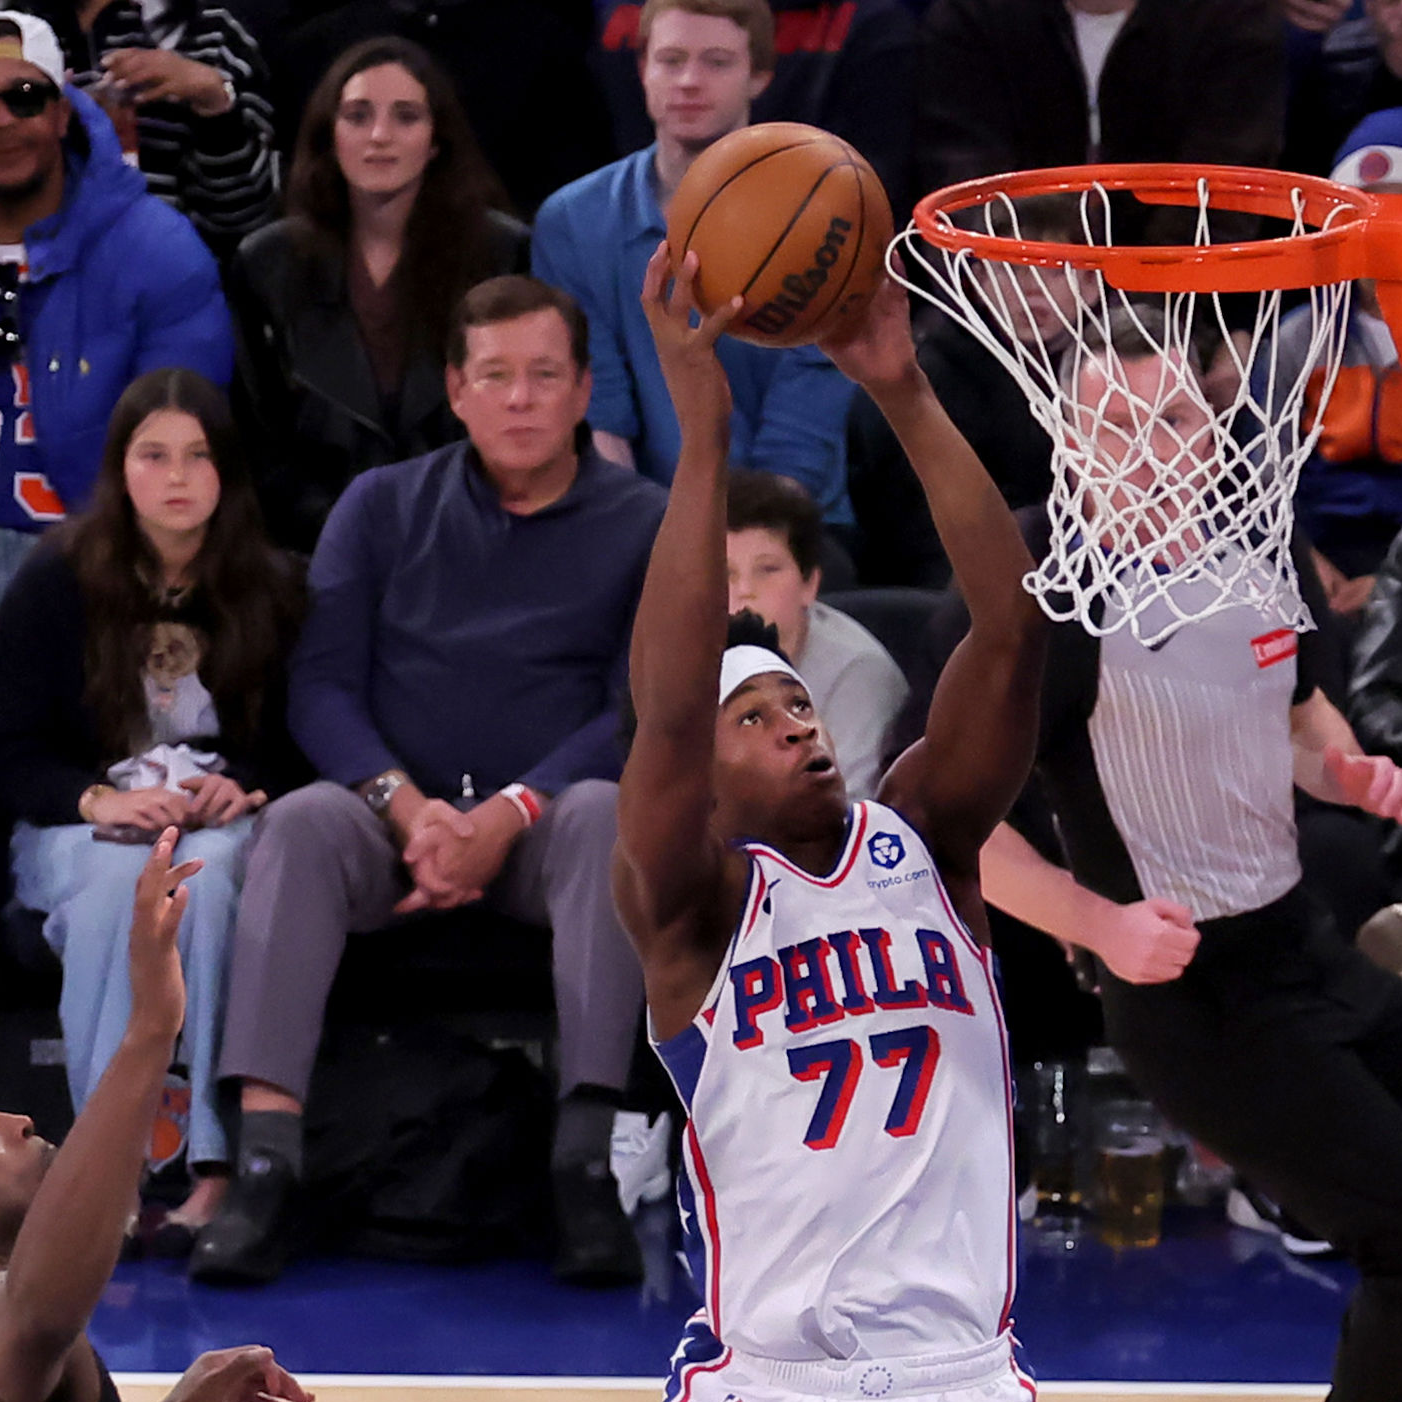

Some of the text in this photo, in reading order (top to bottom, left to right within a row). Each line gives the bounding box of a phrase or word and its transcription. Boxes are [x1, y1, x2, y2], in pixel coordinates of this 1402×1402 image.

[745, 217, 852, 334] Wilson
[730, 927, 976, 1052] PHILA
[786, 1025, 941, 1151] 77
